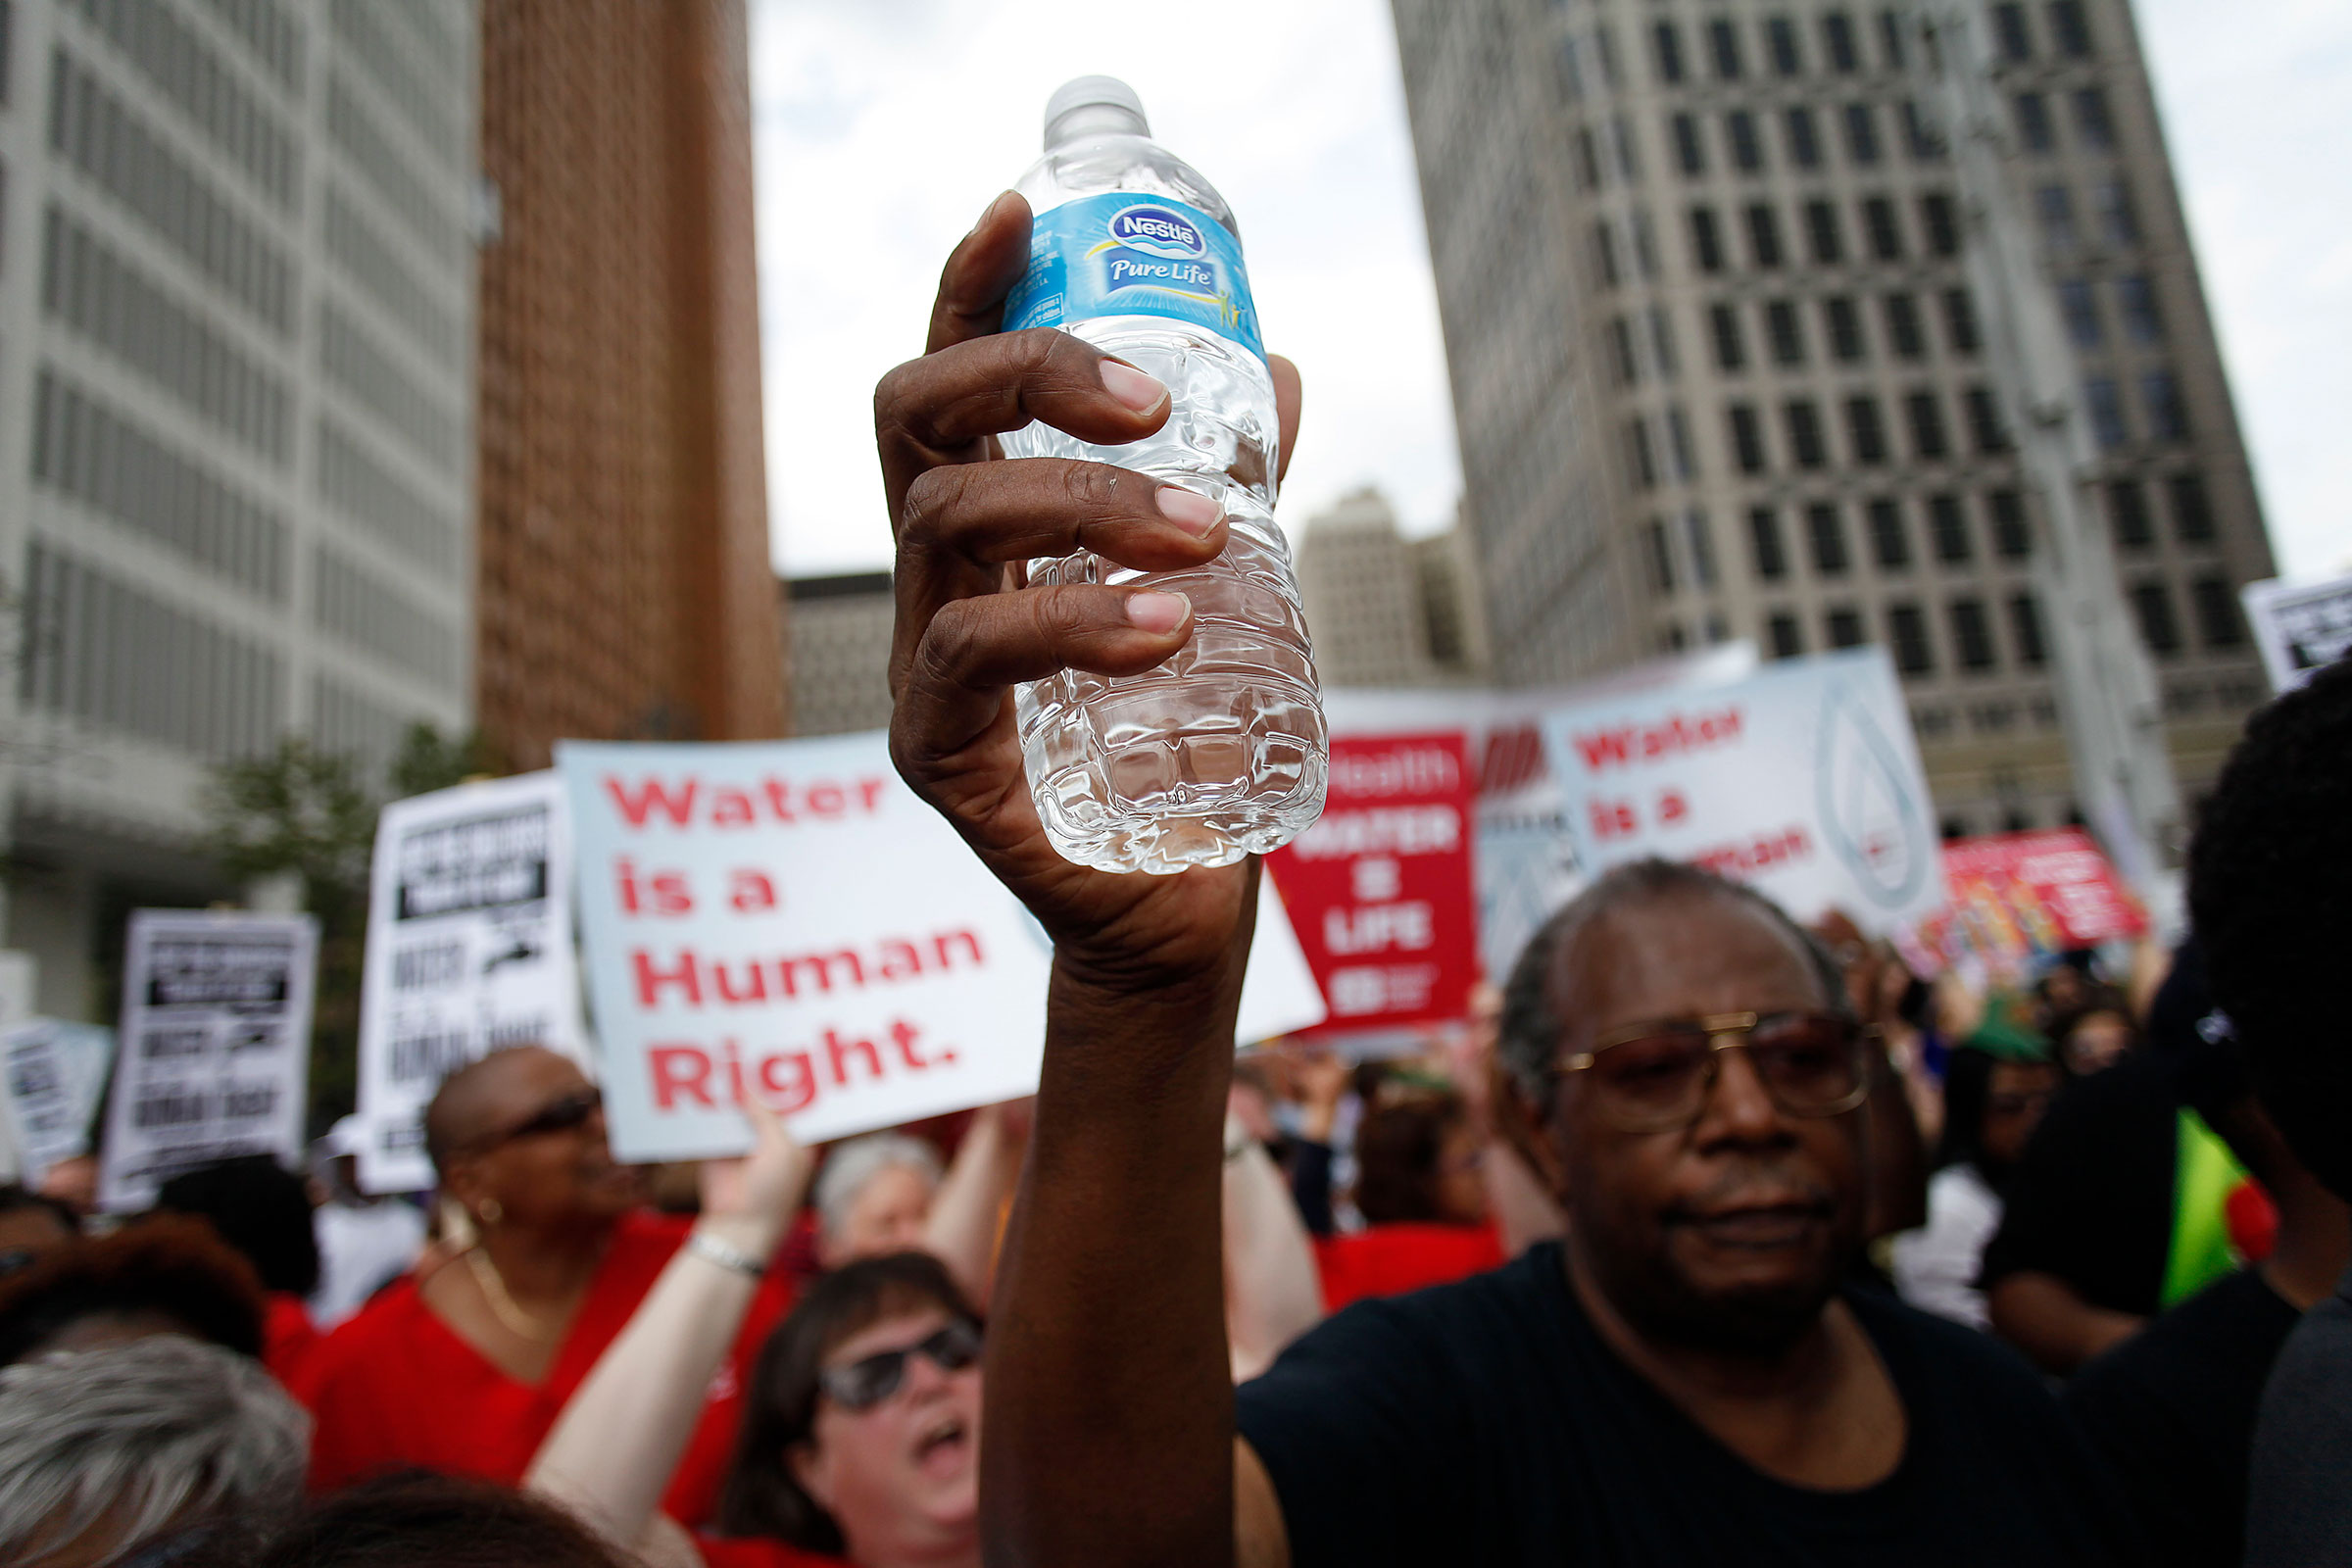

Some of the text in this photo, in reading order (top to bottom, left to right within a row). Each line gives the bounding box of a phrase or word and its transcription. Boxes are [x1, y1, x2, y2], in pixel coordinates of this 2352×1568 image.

[1122, 216, 1195, 245] Nestlé
[1110, 259, 1211, 285] Pure Life
[1576, 708, 1742, 771] Water
[1327, 747, 1460, 796] ealth
[602, 772, 888, 828] Water
[1587, 792, 1637, 842] is
[1657, 788, 1688, 823] a
[615, 856, 778, 917] is a
[1323, 903, 1434, 955] LIFE
[631, 927, 986, 1008] Human
[648, 1018, 958, 1115] Right.
